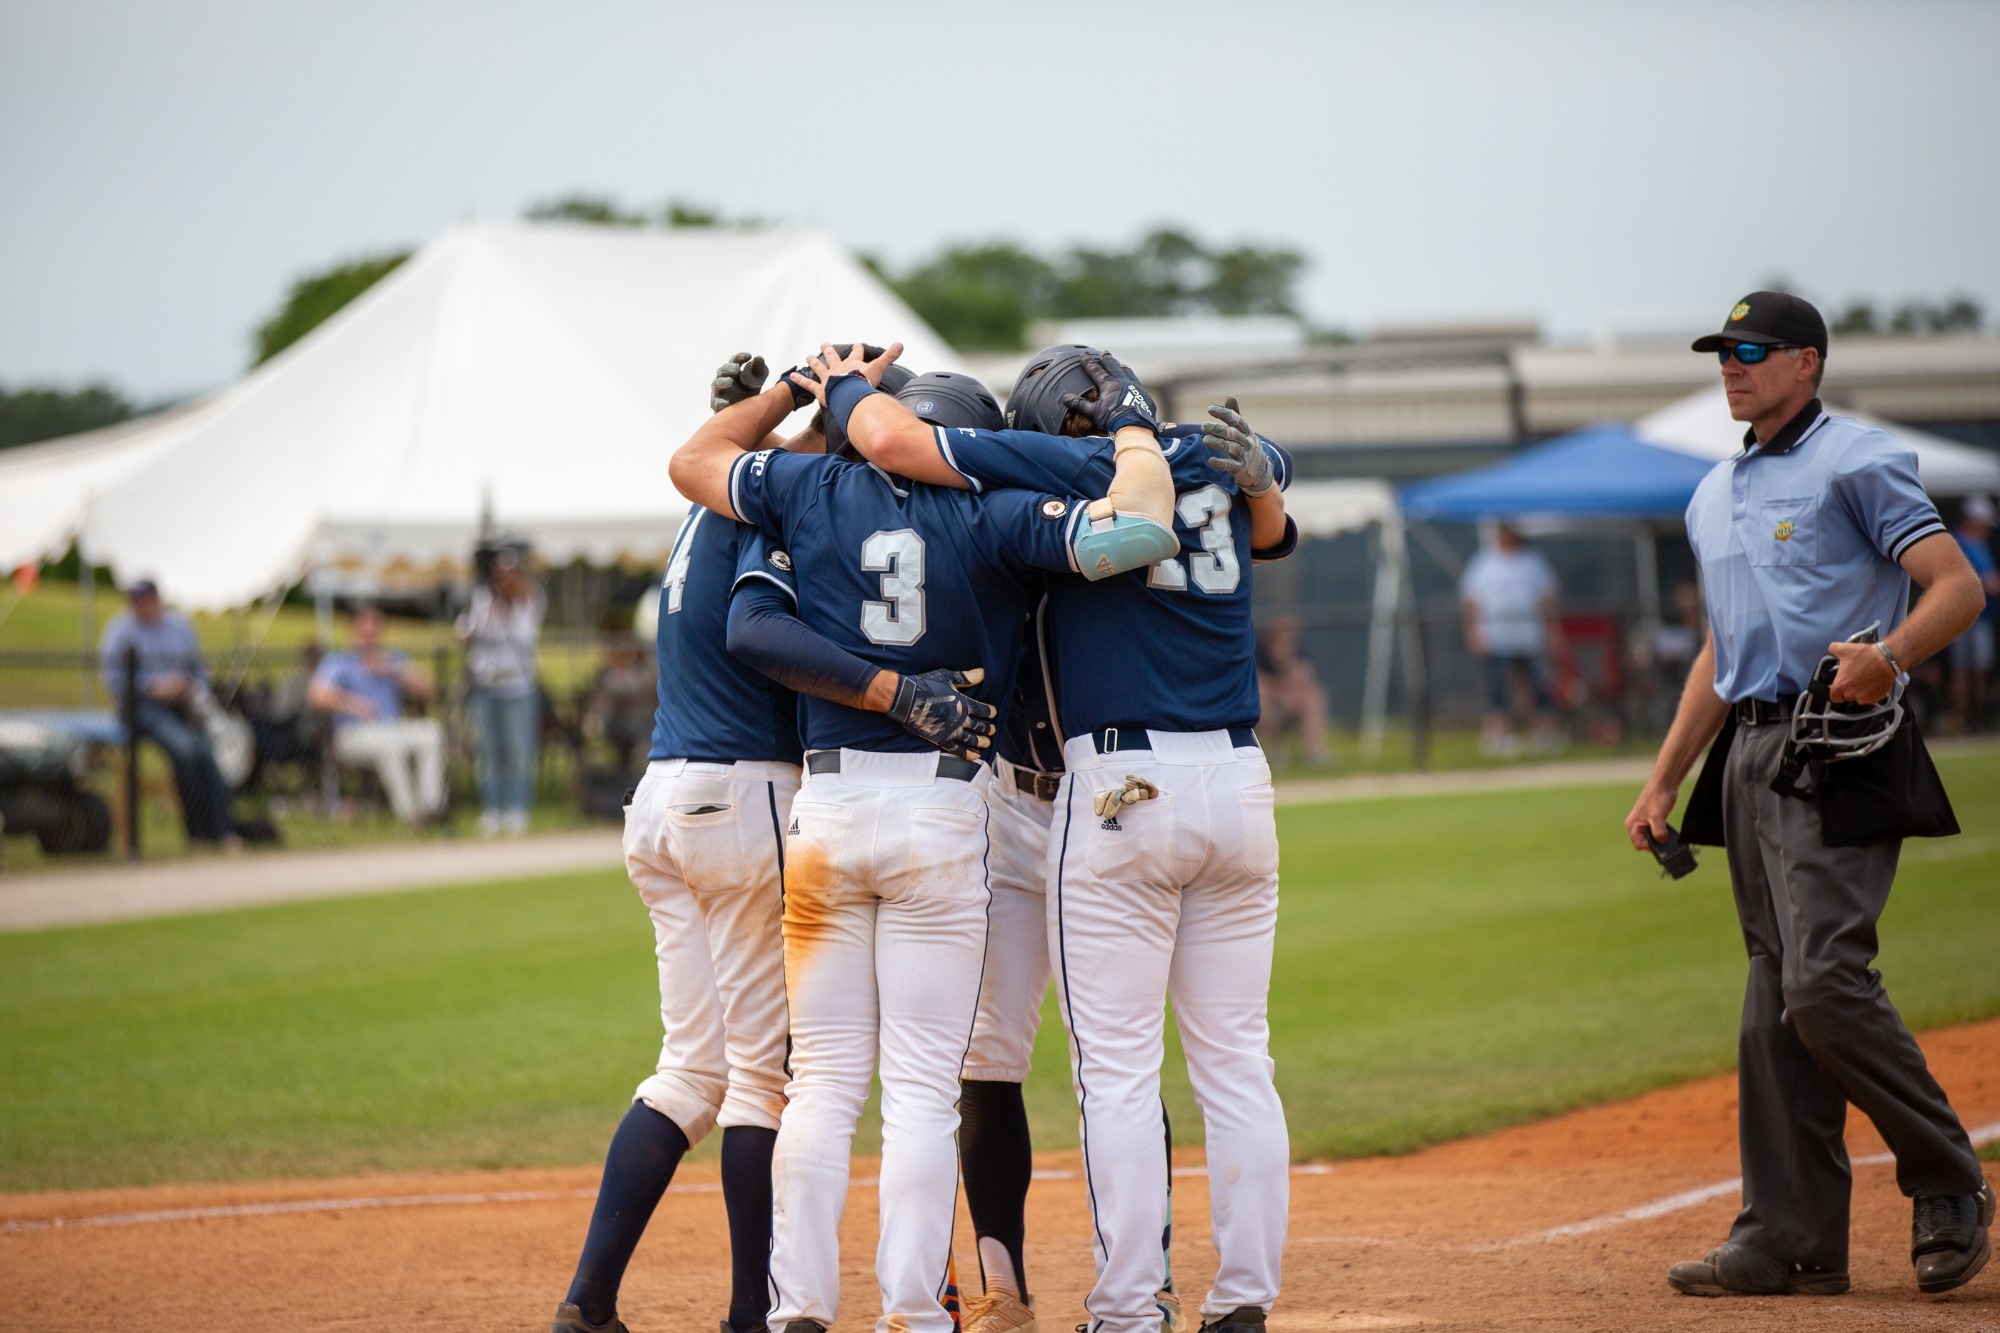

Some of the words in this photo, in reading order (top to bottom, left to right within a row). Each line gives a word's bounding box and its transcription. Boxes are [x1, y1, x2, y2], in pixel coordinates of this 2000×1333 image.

[657, 506, 708, 615] 4
[860, 527, 927, 647] 3
[1146, 483, 1241, 594] 3
